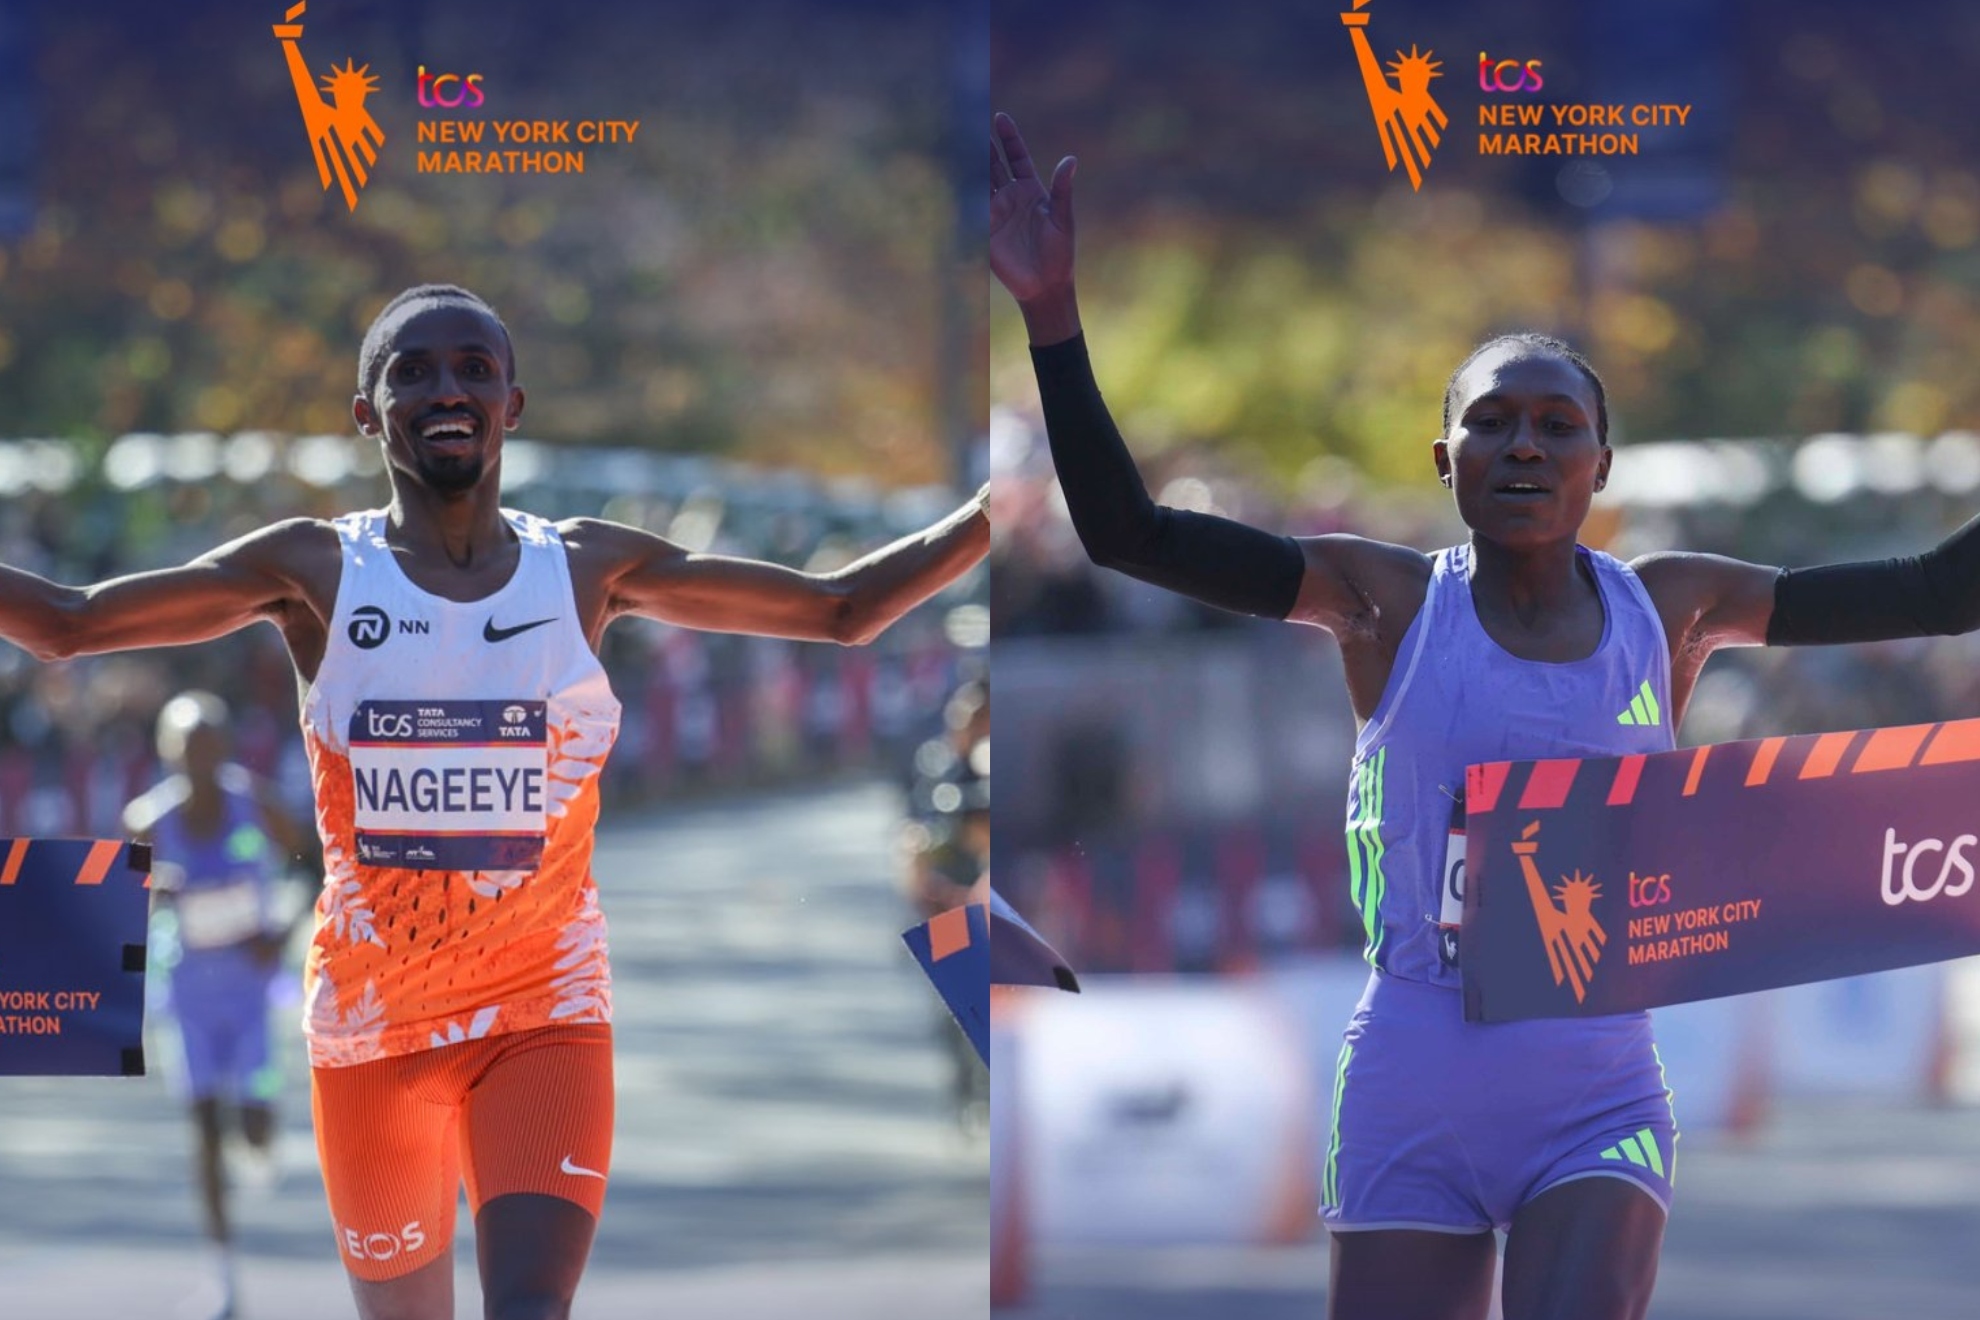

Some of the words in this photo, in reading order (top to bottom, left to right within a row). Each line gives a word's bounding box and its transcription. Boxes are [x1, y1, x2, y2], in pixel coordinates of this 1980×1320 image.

[400, 620, 430, 634] NN
[368, 708, 413, 737] tcs
[417, 718, 482, 728] CONSULTANCY
[418, 708, 445, 717] TATA
[417, 728, 459, 738] SERVICES
[499, 727, 531, 737] TATA
[355, 768, 543, 813] NAGEEYE
[1881, 827, 1978, 906] tcs
[1629, 871, 1671, 908] tcs
[1629, 914, 1670, 939] NEW
[1674, 906, 1719, 931] YORK
[1723, 899, 1761, 923] CITY
[1629, 930, 1728, 965] MARATHON
[0, 992, 50, 1010] YORK
[54, 992, 101, 1010] CITY
